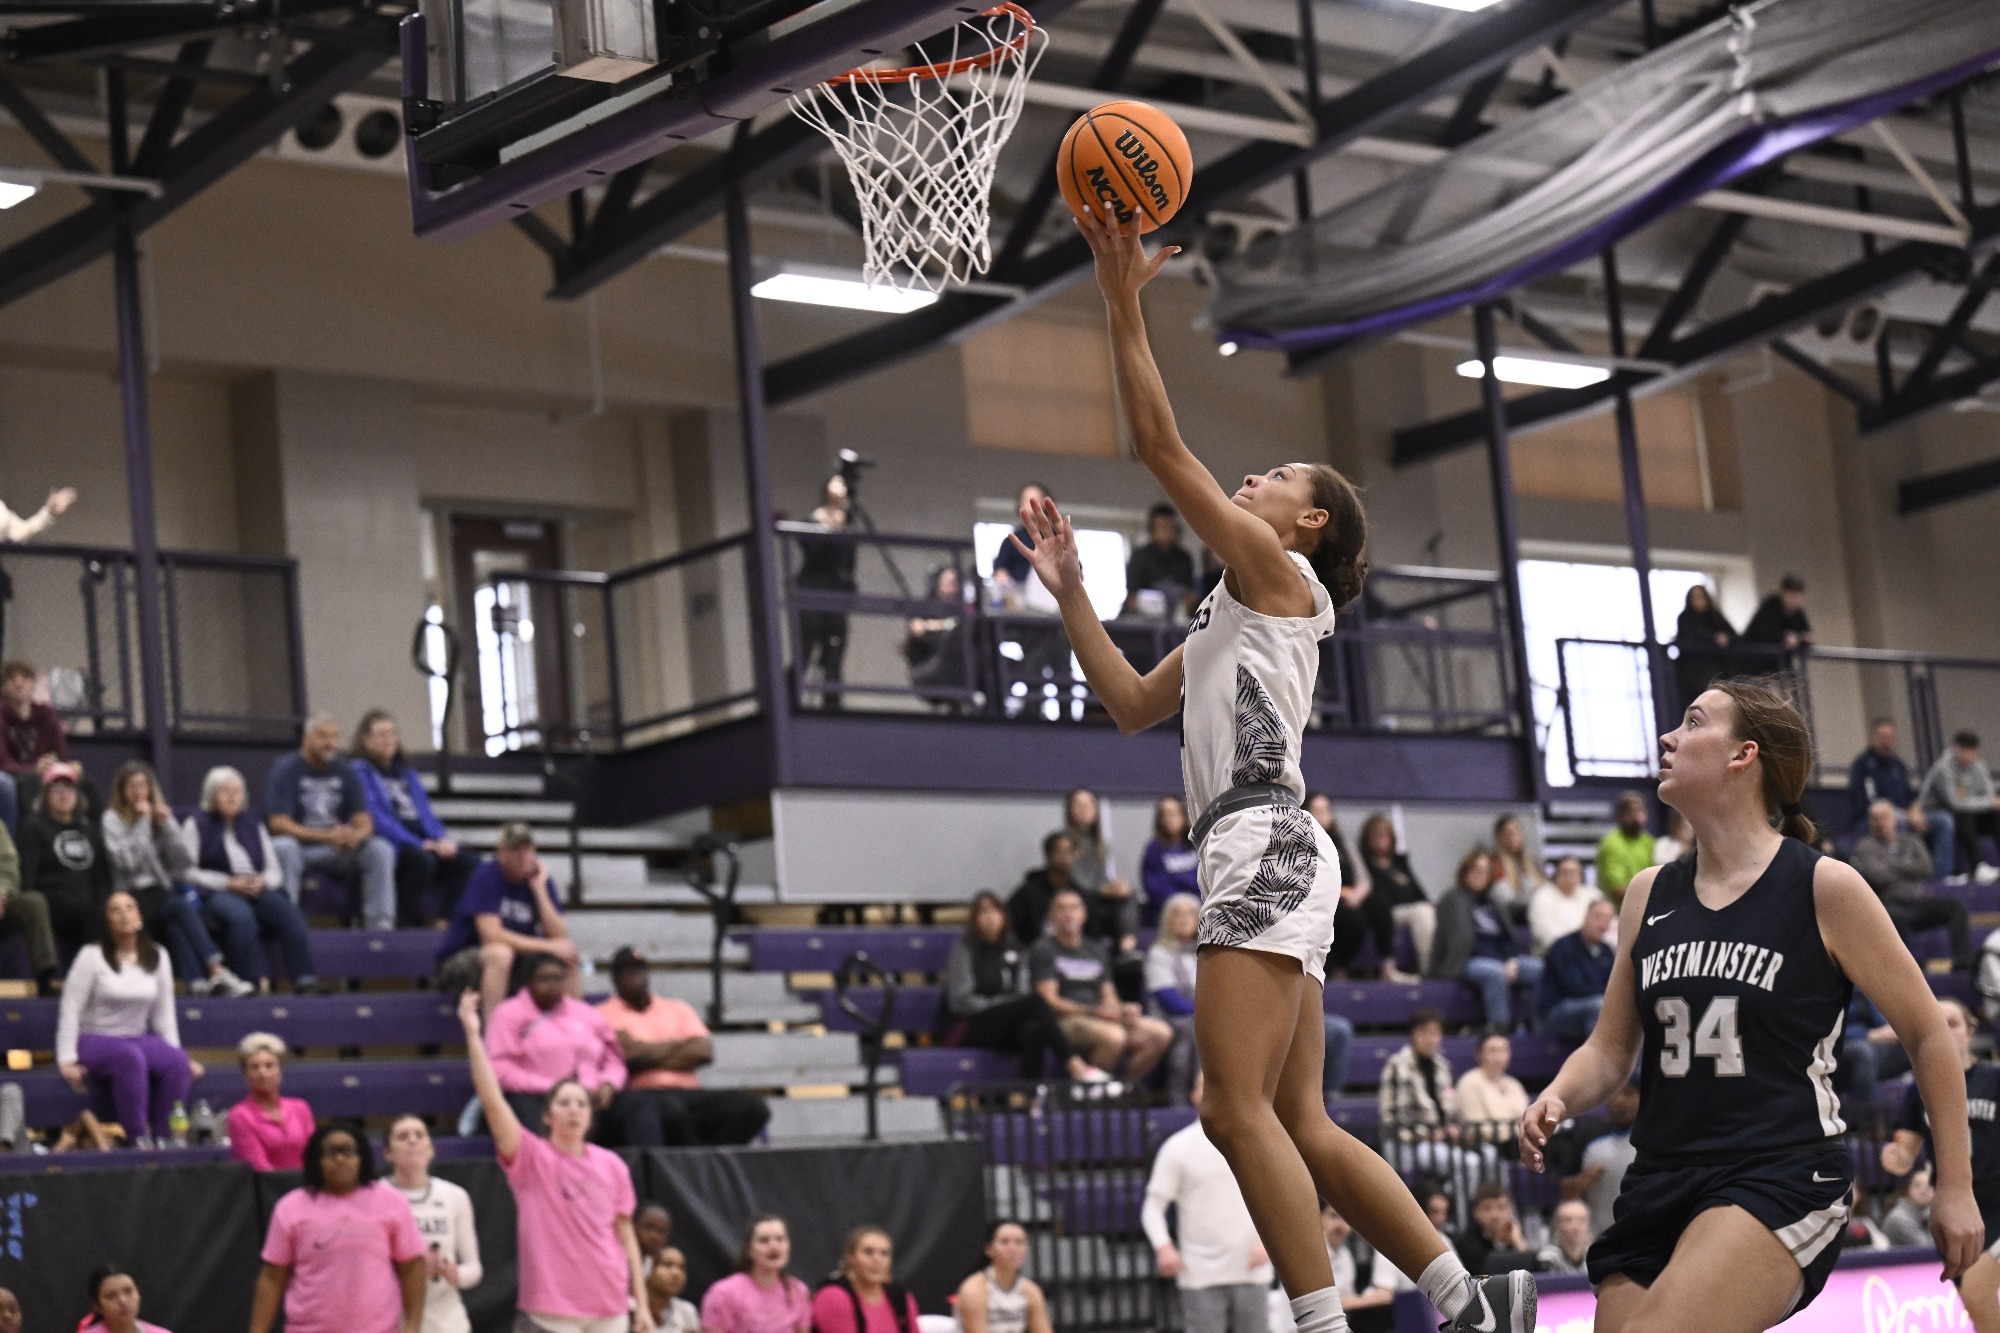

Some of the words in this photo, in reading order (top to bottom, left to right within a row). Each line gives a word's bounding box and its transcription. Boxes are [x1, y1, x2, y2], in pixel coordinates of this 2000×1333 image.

[1115, 128, 1169, 212] Wilson
[1641, 940, 1784, 992] WESTMINSTER
[1654, 995, 1746, 1078] 34
